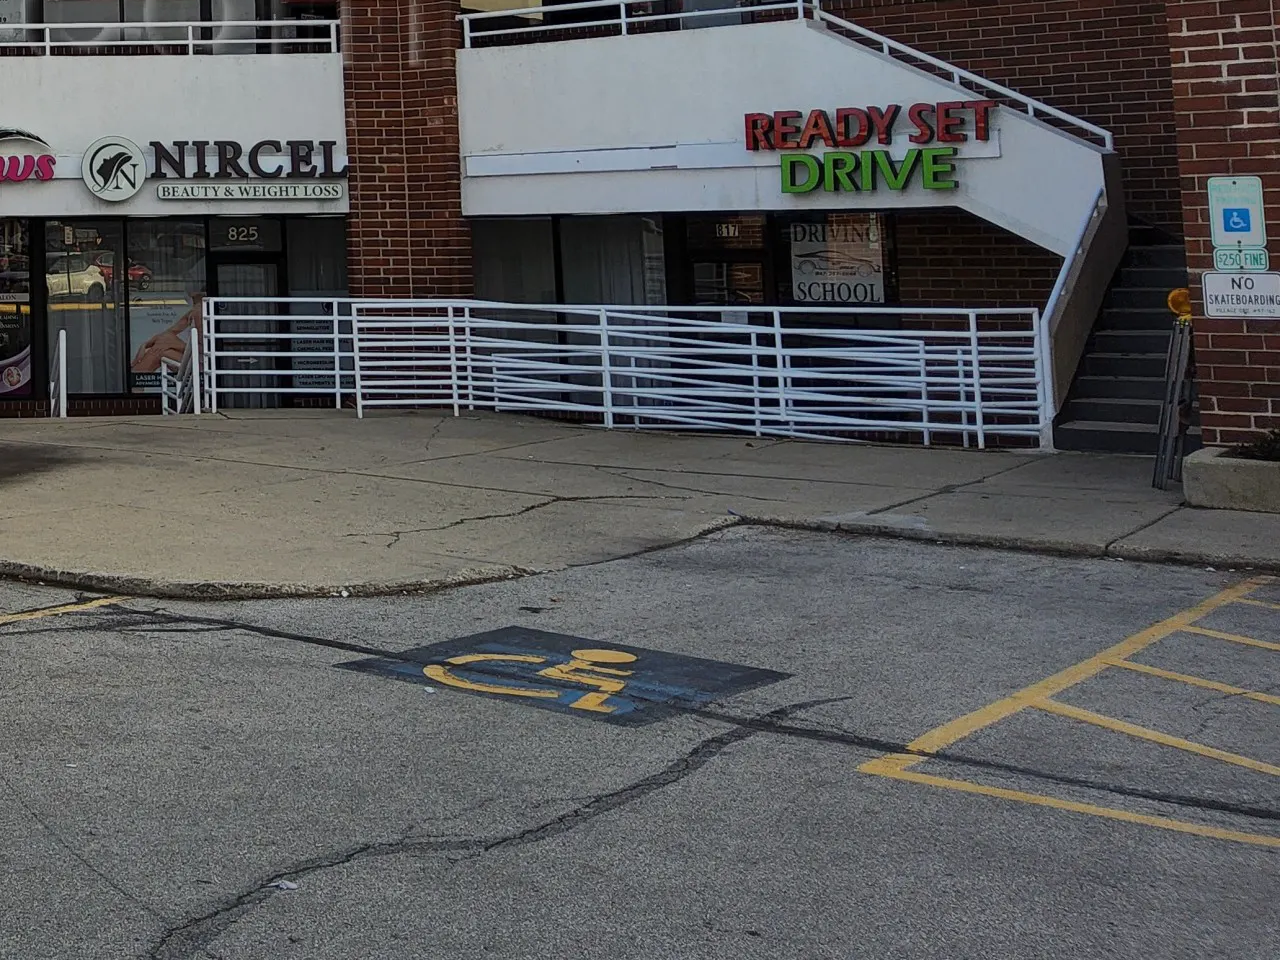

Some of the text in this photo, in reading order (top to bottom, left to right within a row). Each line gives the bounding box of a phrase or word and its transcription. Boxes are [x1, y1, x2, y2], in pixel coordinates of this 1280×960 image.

[744, 99, 1000, 151] READY SET
[148, 139, 347, 180] NIRCEL
[781, 147, 959, 195] DRIVE
[162, 185, 339, 199] BEAUTY & WEIGHT LOSS
[228, 226, 258, 241] 825
[717, 224, 737, 236] 817
[793, 224, 878, 243] DRIVING
[1218, 253, 1265, 266] $250 FINE
[1231, 277, 1254, 290] NO
[797, 281, 880, 302] SCHOOL
[1208, 294, 1280, 306] SKATEBOARDING
